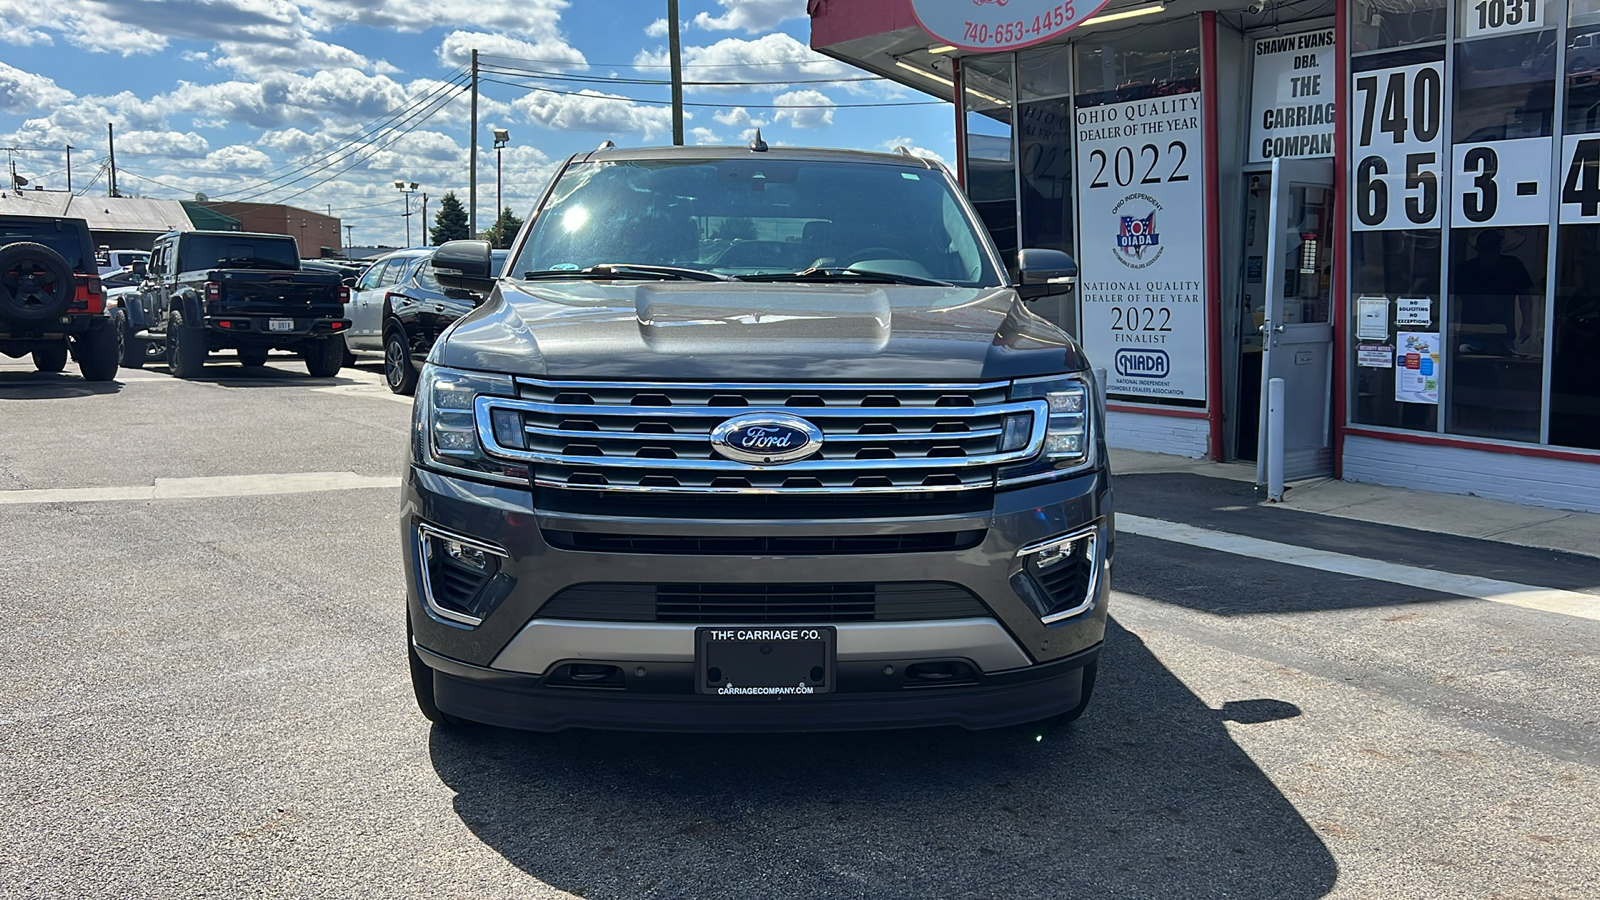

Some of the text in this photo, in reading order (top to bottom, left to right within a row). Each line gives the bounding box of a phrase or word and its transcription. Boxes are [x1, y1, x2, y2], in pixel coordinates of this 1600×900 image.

[963, 0, 1075, 43] 740-653-4455
[1475, 0, 1536, 30] 1031
[1256, 37, 1295, 55] SHAWN
[1294, 54, 1319, 70] DBA.
[1290, 74, 1321, 98] THE
[1078, 108, 1117, 125] OHIO
[1125, 96, 1199, 121] QUALITY
[1263, 103, 1335, 130] CARRIAG
[1356, 67, 1441, 147] 740
[1080, 117, 1197, 141] DEALER OF THE YEAR
[1089, 141, 1189, 188] 2022
[1112, 192, 1163, 215] OHIO INDEPENDENT
[1121, 235, 1152, 246] OIADA
[1084, 281, 1200, 292] NATIONAL QUALITY
[1085, 294, 1199, 302] DEALER OF THE YEAR
[1111, 307, 1172, 332] 2022
[1115, 334, 1167, 343] FINALIST
[1120, 354, 1165, 372] NIADA
[1132, 386, 1151, 394] DEALERS
[1152, 388, 1184, 396] ASSOCIATION
[1139, 379, 1170, 387] INDEPENDENT
[742, 426, 792, 447] Ford
[710, 630, 821, 640] THE CARRIAGE CO.
[717, 687, 814, 695] CARRIAGECOMPANY.COM
